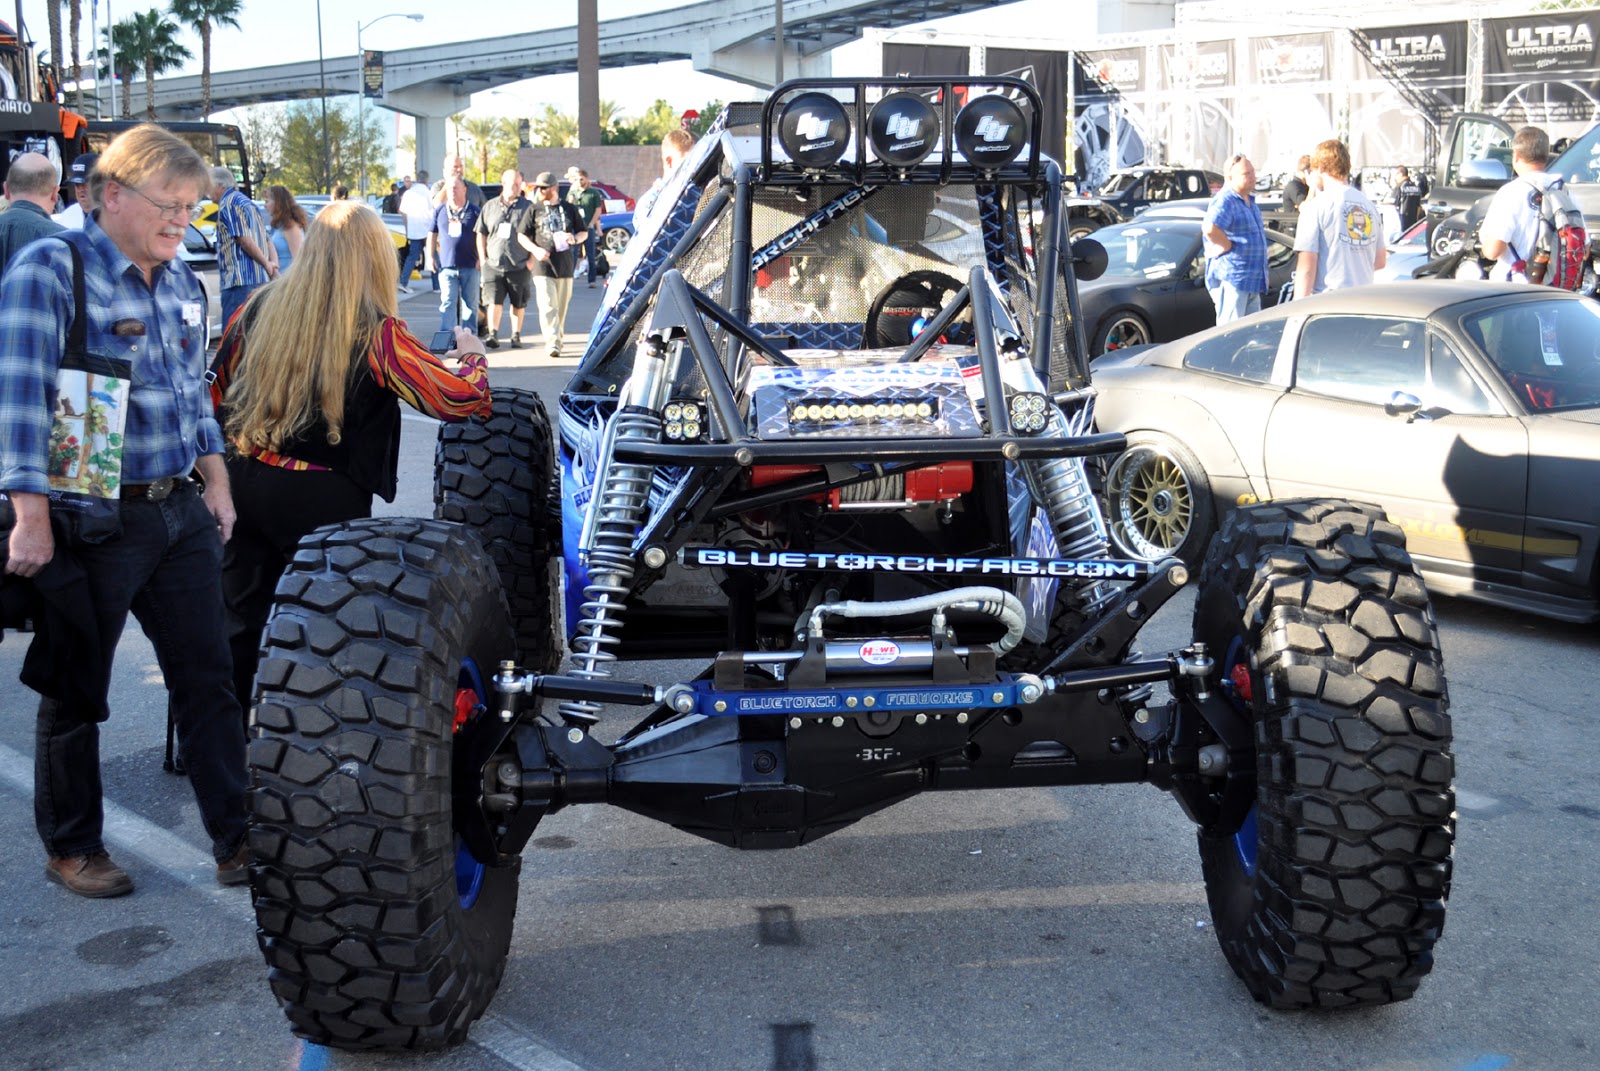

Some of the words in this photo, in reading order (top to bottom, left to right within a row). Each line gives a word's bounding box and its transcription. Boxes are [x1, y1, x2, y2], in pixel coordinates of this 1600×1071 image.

[1370, 34, 1447, 57] ULTRA
[1506, 23, 1593, 48] ULTRA
[1506, 43, 1593, 57] MOTORSPORTS
[698, 549, 1136, 579] BLUETORCHFAB.COM
[739, 696, 837, 710] BLUETORCH
[886, 691, 974, 705] FABWORKS
